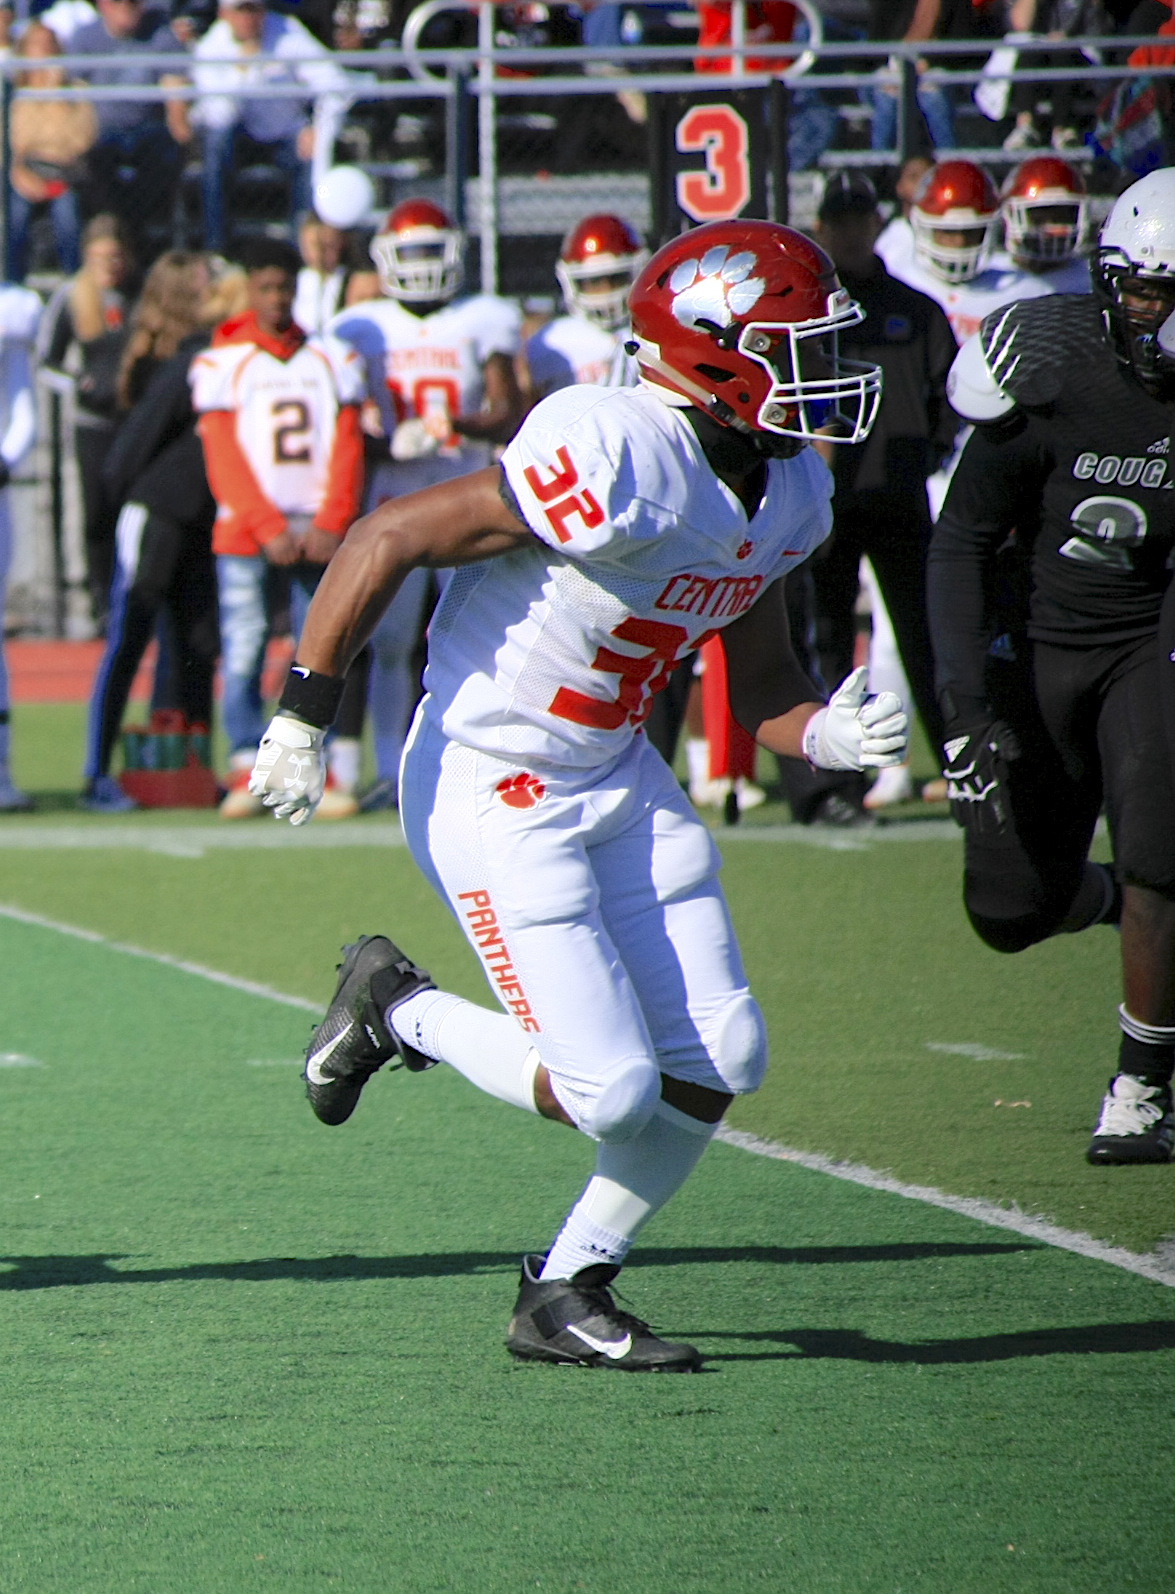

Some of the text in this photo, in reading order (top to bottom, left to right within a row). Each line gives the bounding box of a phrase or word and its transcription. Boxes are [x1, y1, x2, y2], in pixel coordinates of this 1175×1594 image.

[675, 104, 751, 221] 3
[271, 400, 311, 464] 2
[1073, 452, 1174, 489] COUG
[523, 444, 605, 544] 32
[655, 573, 765, 618] CENTRA
[457, 889, 542, 1033] PANTHERS
